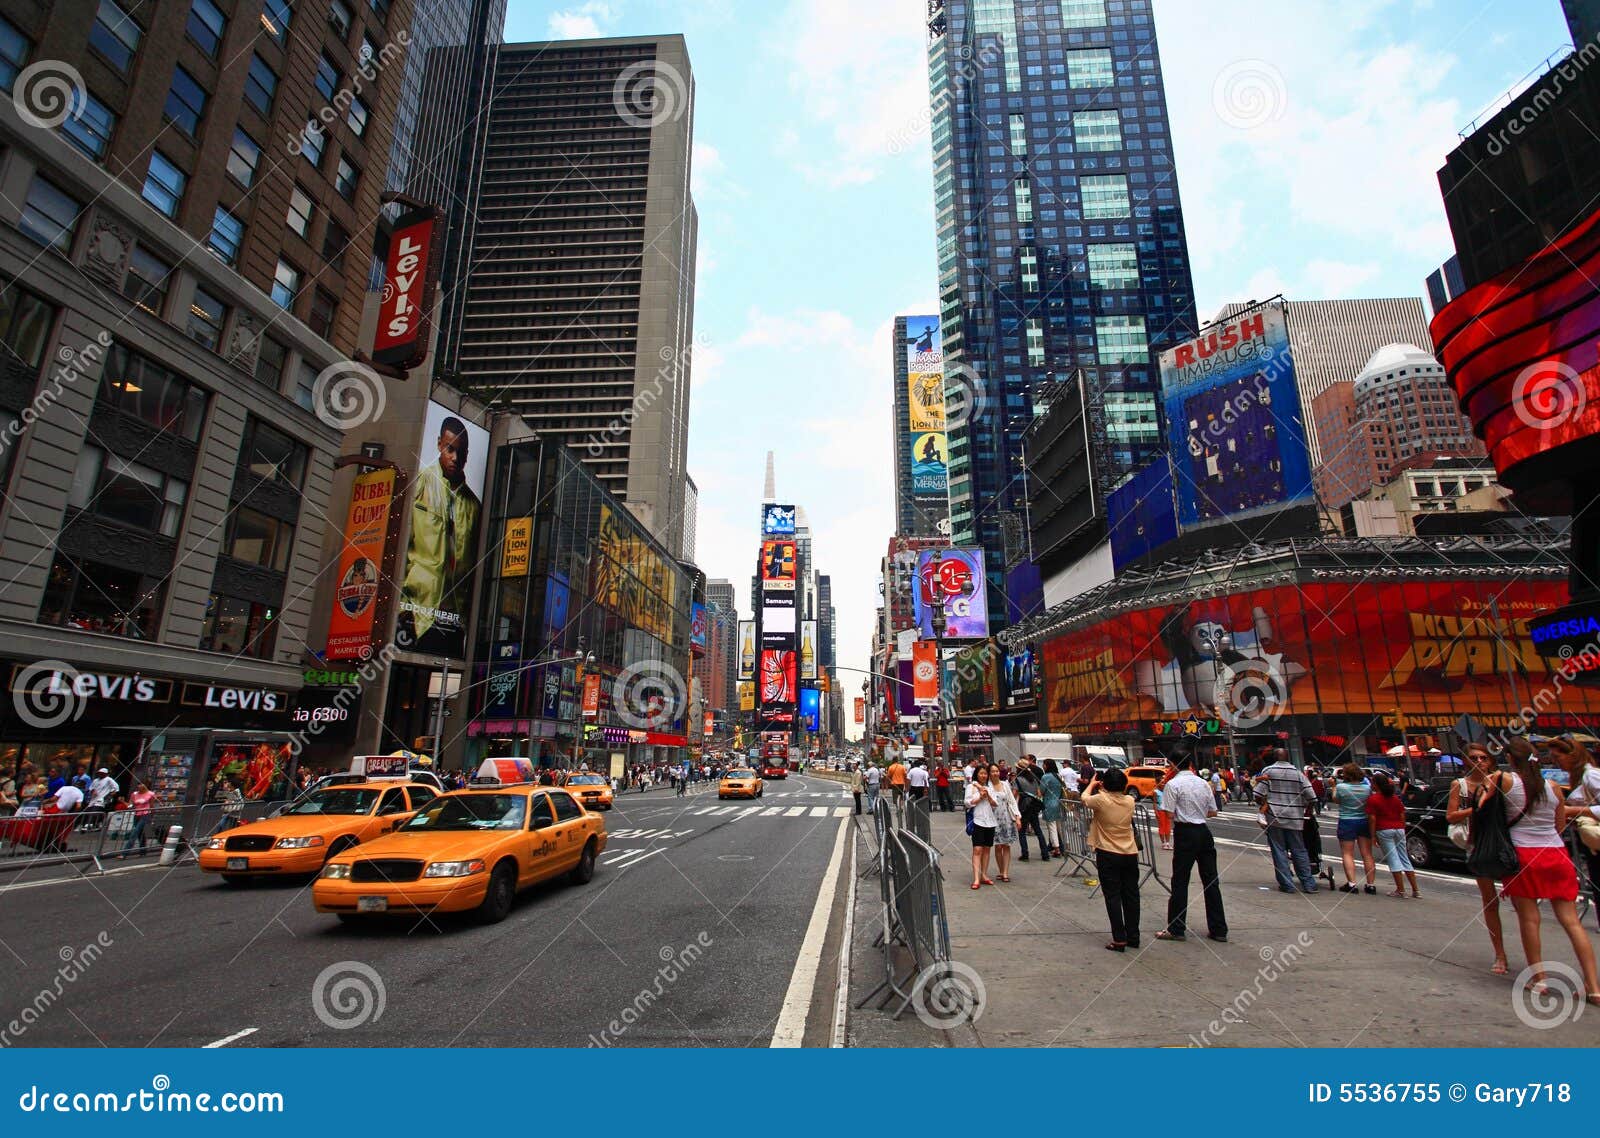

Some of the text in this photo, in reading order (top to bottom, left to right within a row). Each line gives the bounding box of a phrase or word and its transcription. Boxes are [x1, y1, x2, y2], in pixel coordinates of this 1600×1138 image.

[388, 236, 421, 337] Levi's
[1174, 312, 1265, 369] RUSH
[916, 351, 942, 364] MARY
[1178, 335, 1267, 381] LIMBAUGH
[926, 410, 939, 418] THE
[912, 418, 945, 431] LION KIN
[353, 480, 391, 502] BUBBA
[913, 479, 946, 489] MERMA
[353, 503, 386, 525] GUMP
[512, 527, 526, 537] THE
[507, 540, 528, 554] LION
[505, 554, 526, 568] KING
[765, 597, 793, 606] Samsung
[943, 598, 971, 617] LG
[328, 634, 370, 645] RESTAURANT
[334, 645, 361, 656] MARKET
[1057, 657, 1092, 678] KUNG
[1095, 648, 1114, 669] FU
[48, 670, 156, 701] Levi's
[205, 686, 277, 711] Levi's
[497, 692, 507, 705] 2
[312, 707, 348, 721] 6300
